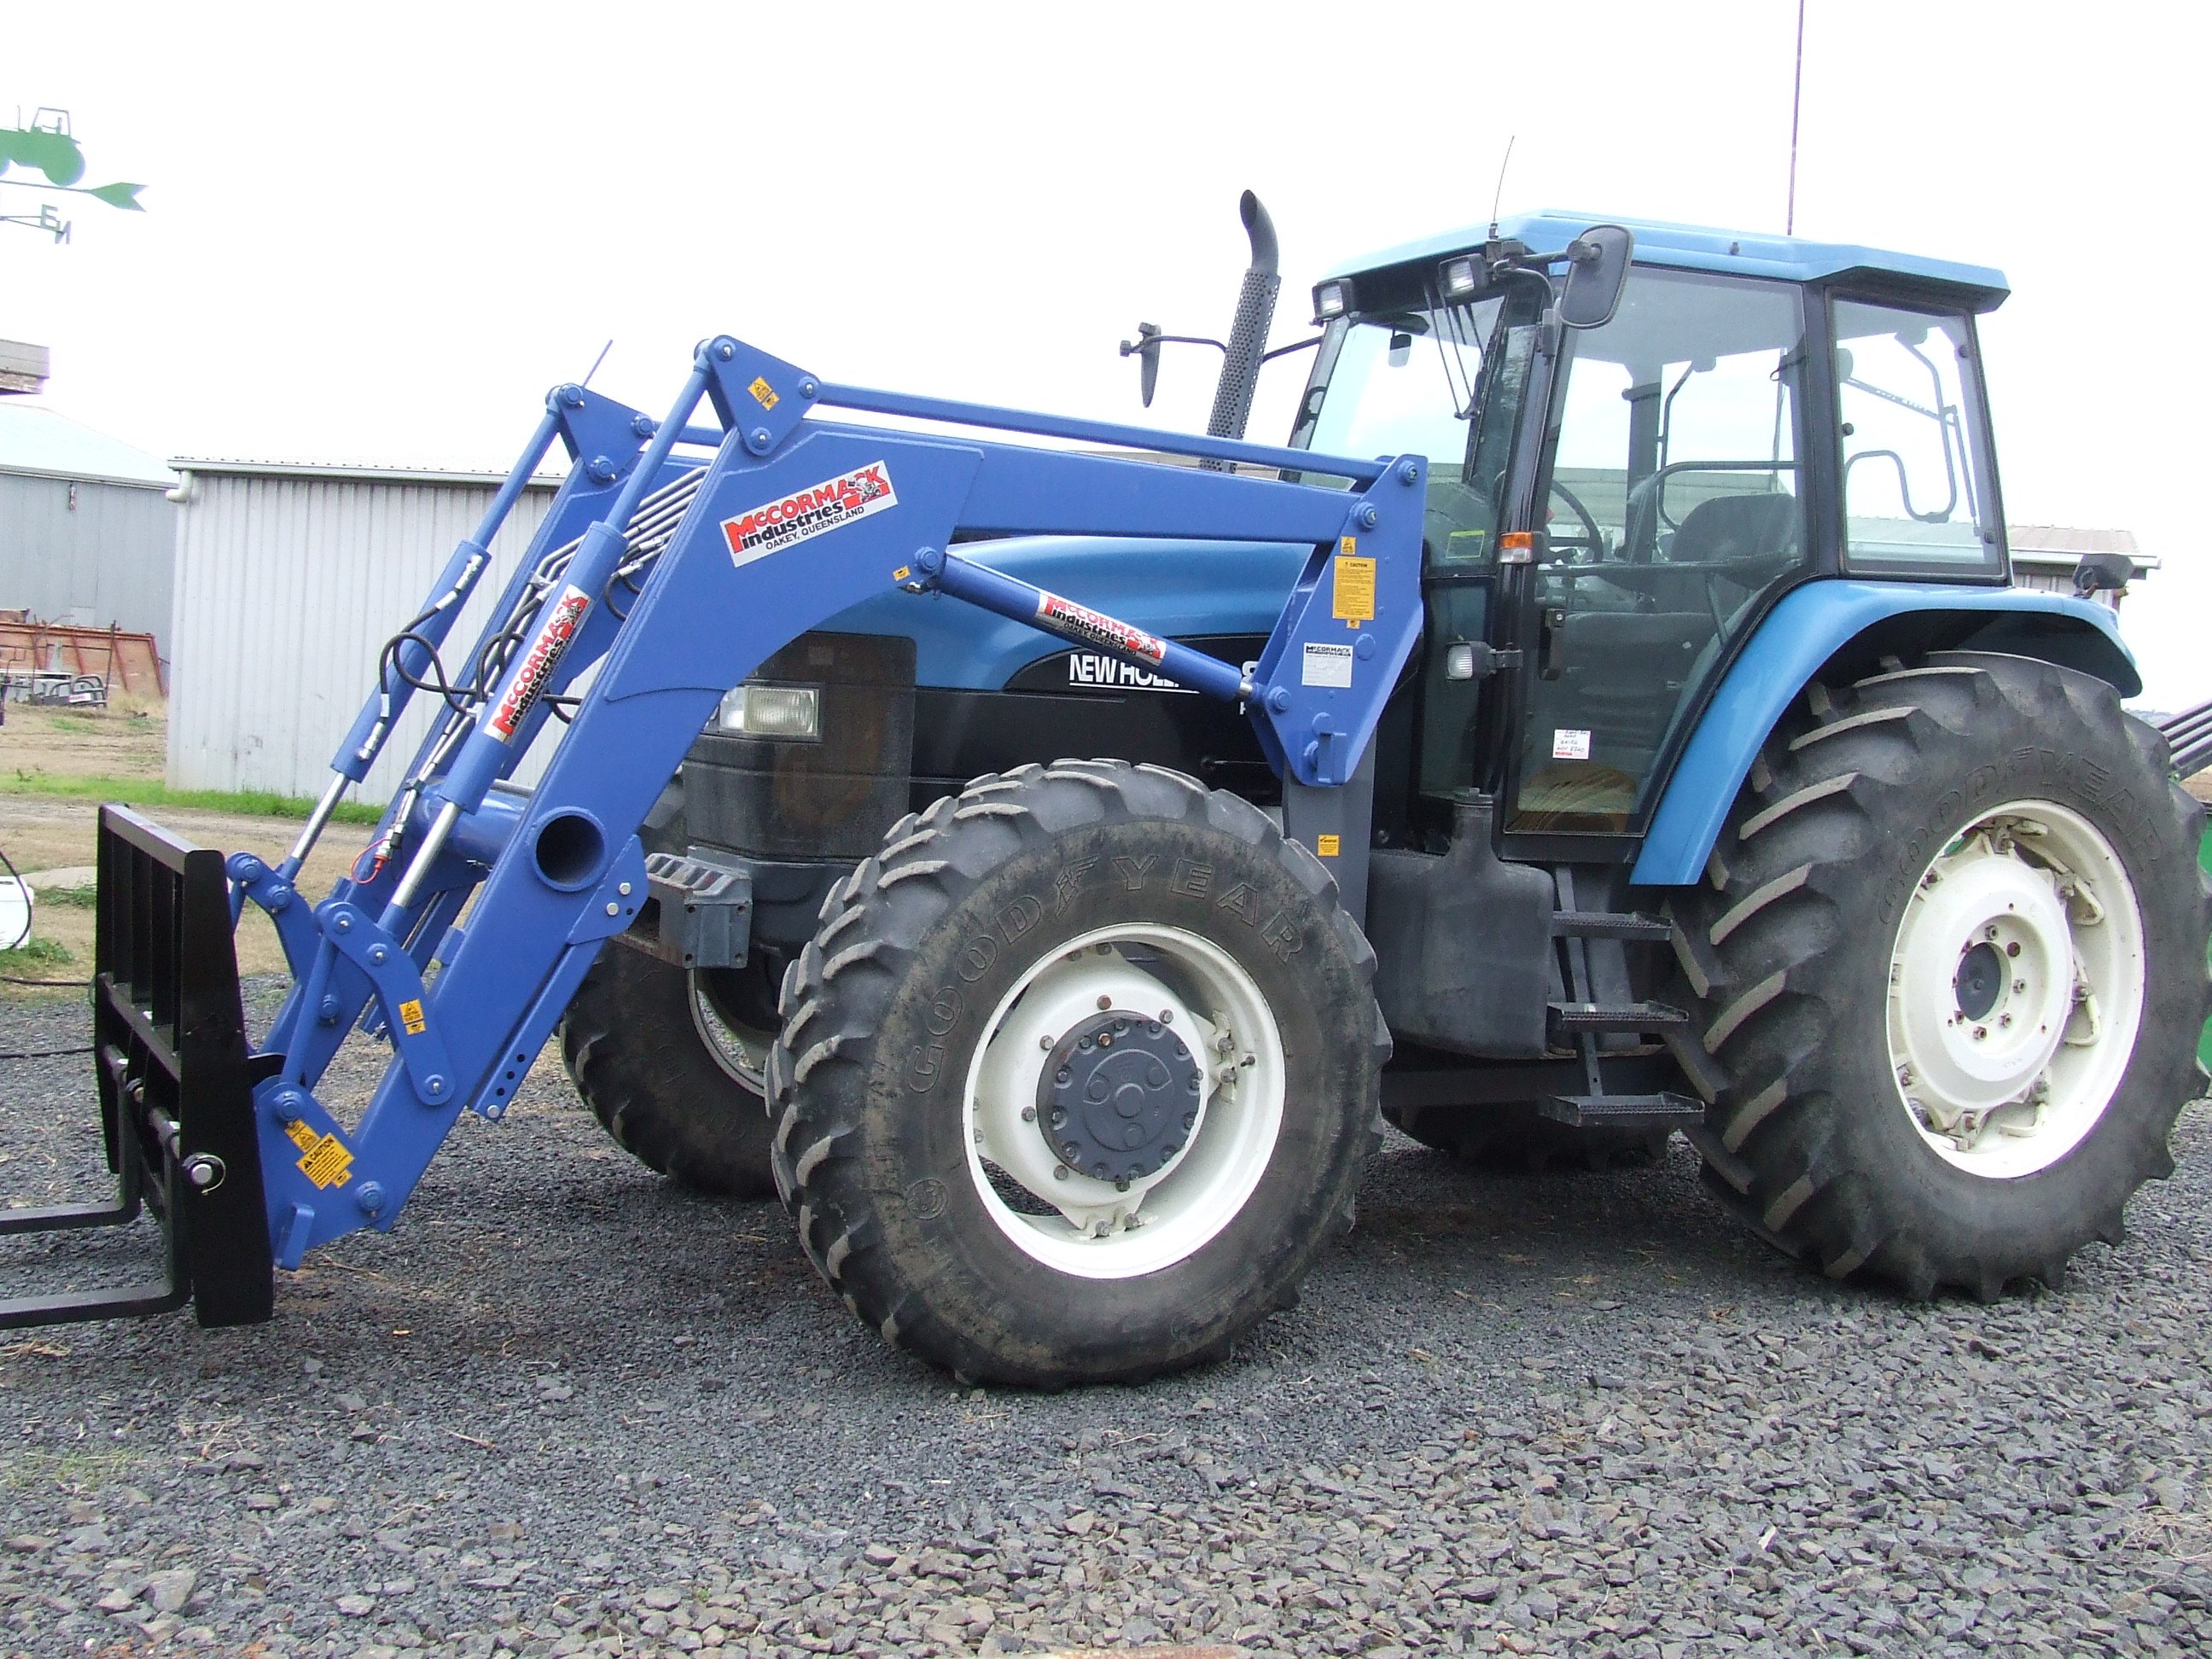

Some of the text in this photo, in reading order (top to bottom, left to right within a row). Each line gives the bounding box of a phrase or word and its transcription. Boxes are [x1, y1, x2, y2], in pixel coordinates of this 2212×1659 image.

[765, 506, 865, 550] OAKEY, QUEENSLAND
[1045, 597, 1161, 649] McCORMAK
[1069, 654, 1117, 684] NEW
